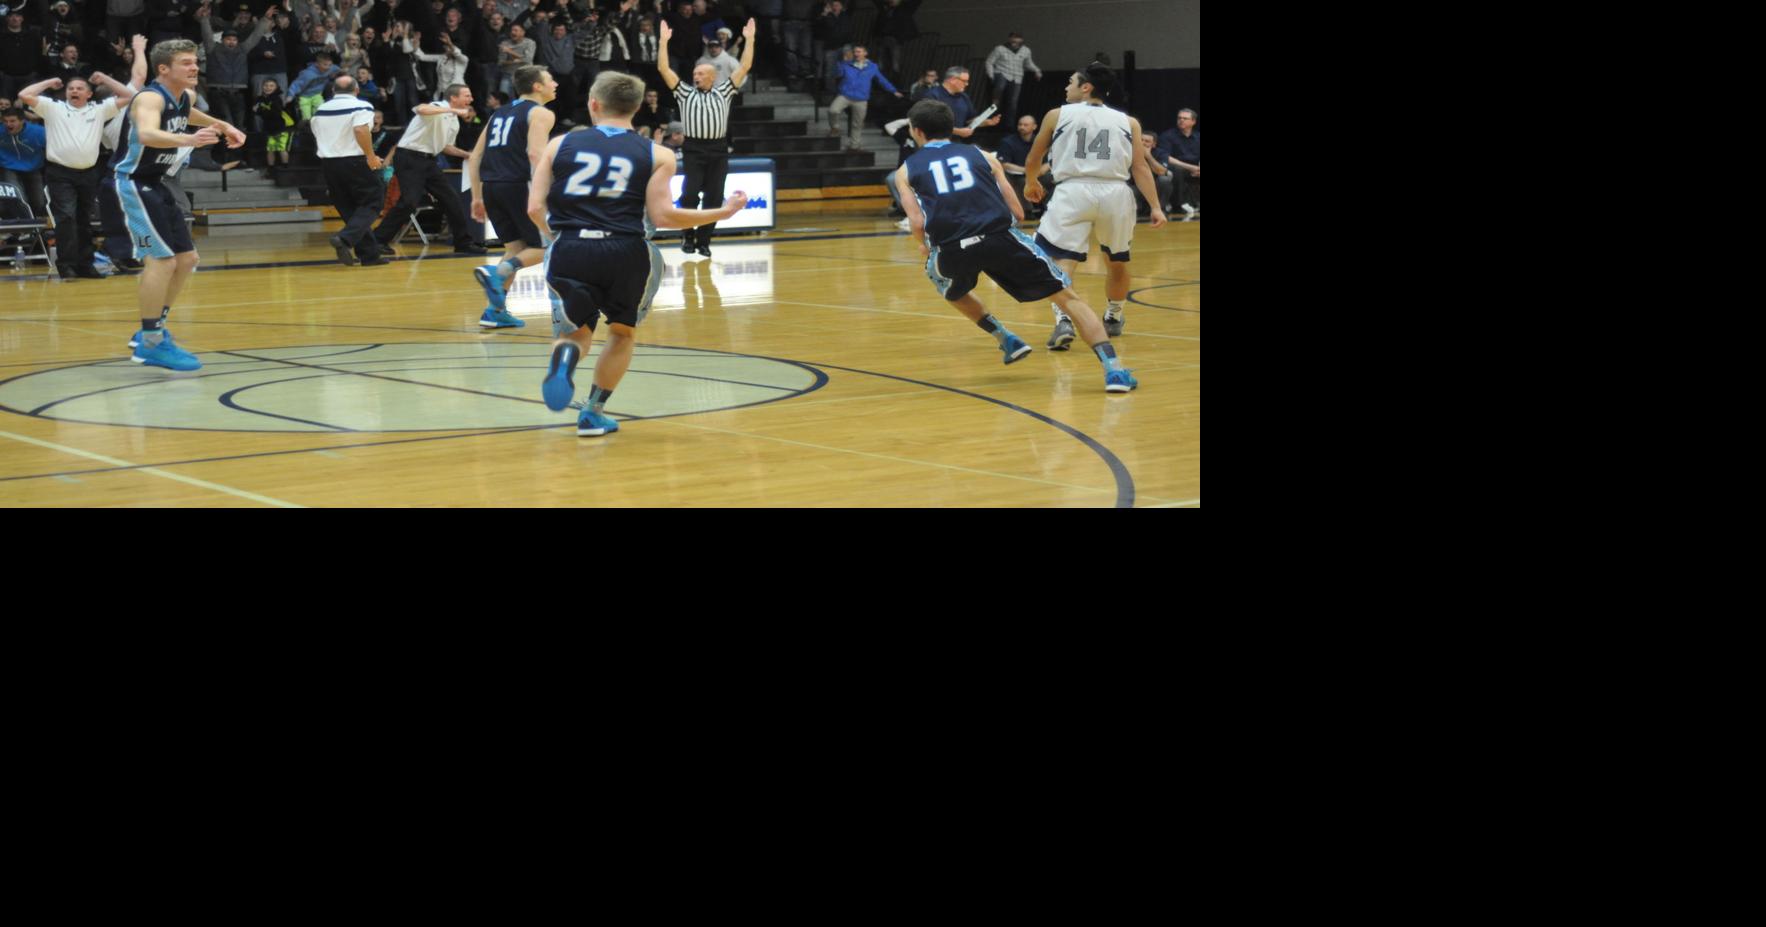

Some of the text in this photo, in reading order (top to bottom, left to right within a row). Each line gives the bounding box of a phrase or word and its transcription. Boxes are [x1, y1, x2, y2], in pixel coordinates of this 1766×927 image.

[488, 116, 515, 147] 31
[1074, 128, 1111, 160] 14
[563, 151, 633, 198] 23
[928, 155, 974, 194] 13
[138, 235, 152, 248] LC
